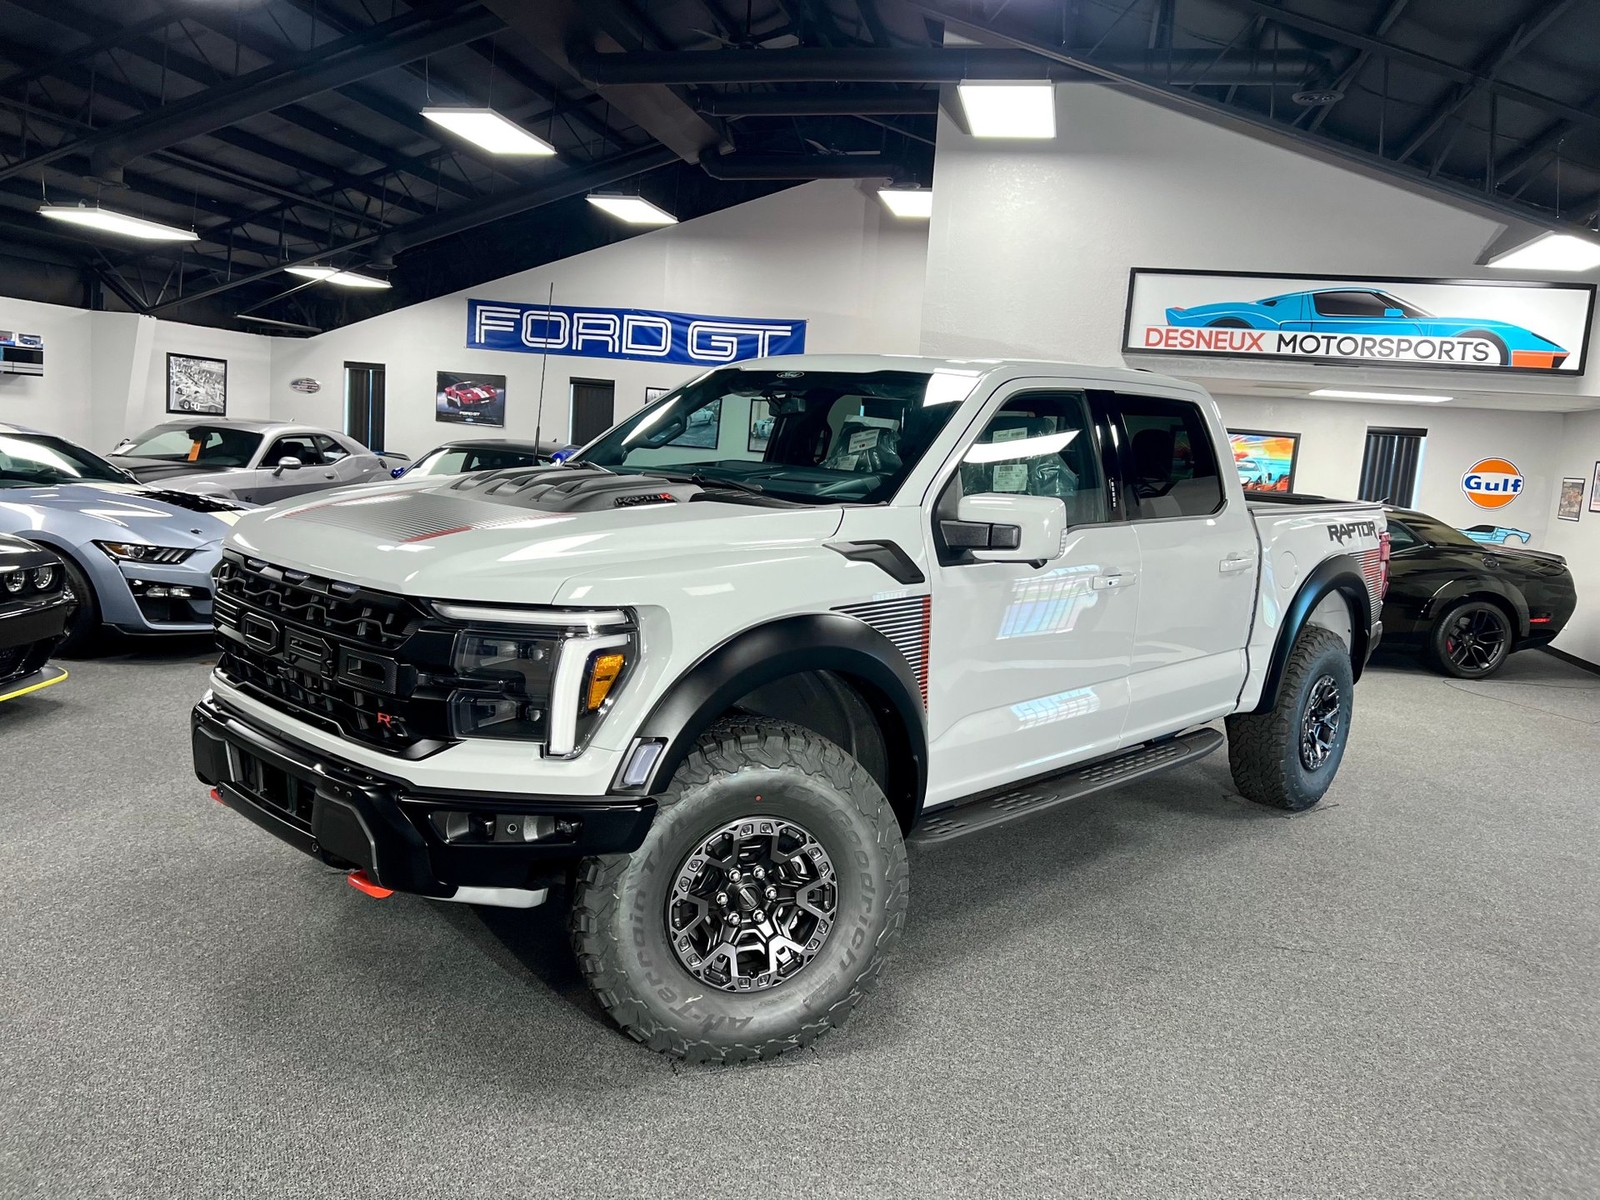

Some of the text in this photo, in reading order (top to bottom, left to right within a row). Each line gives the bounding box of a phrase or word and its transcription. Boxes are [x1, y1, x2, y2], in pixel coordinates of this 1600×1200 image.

[475, 305, 792, 361] FORD GT
[1144, 327, 1490, 361] DESNEUX MOTORSPORTS
[1464, 475, 1522, 492] Gulf
[1327, 521, 1379, 546] RAPTOR
[213, 592, 399, 695] FORD
[377, 712, 391, 728] R
[783, 785, 876, 972] BFGoodrich
